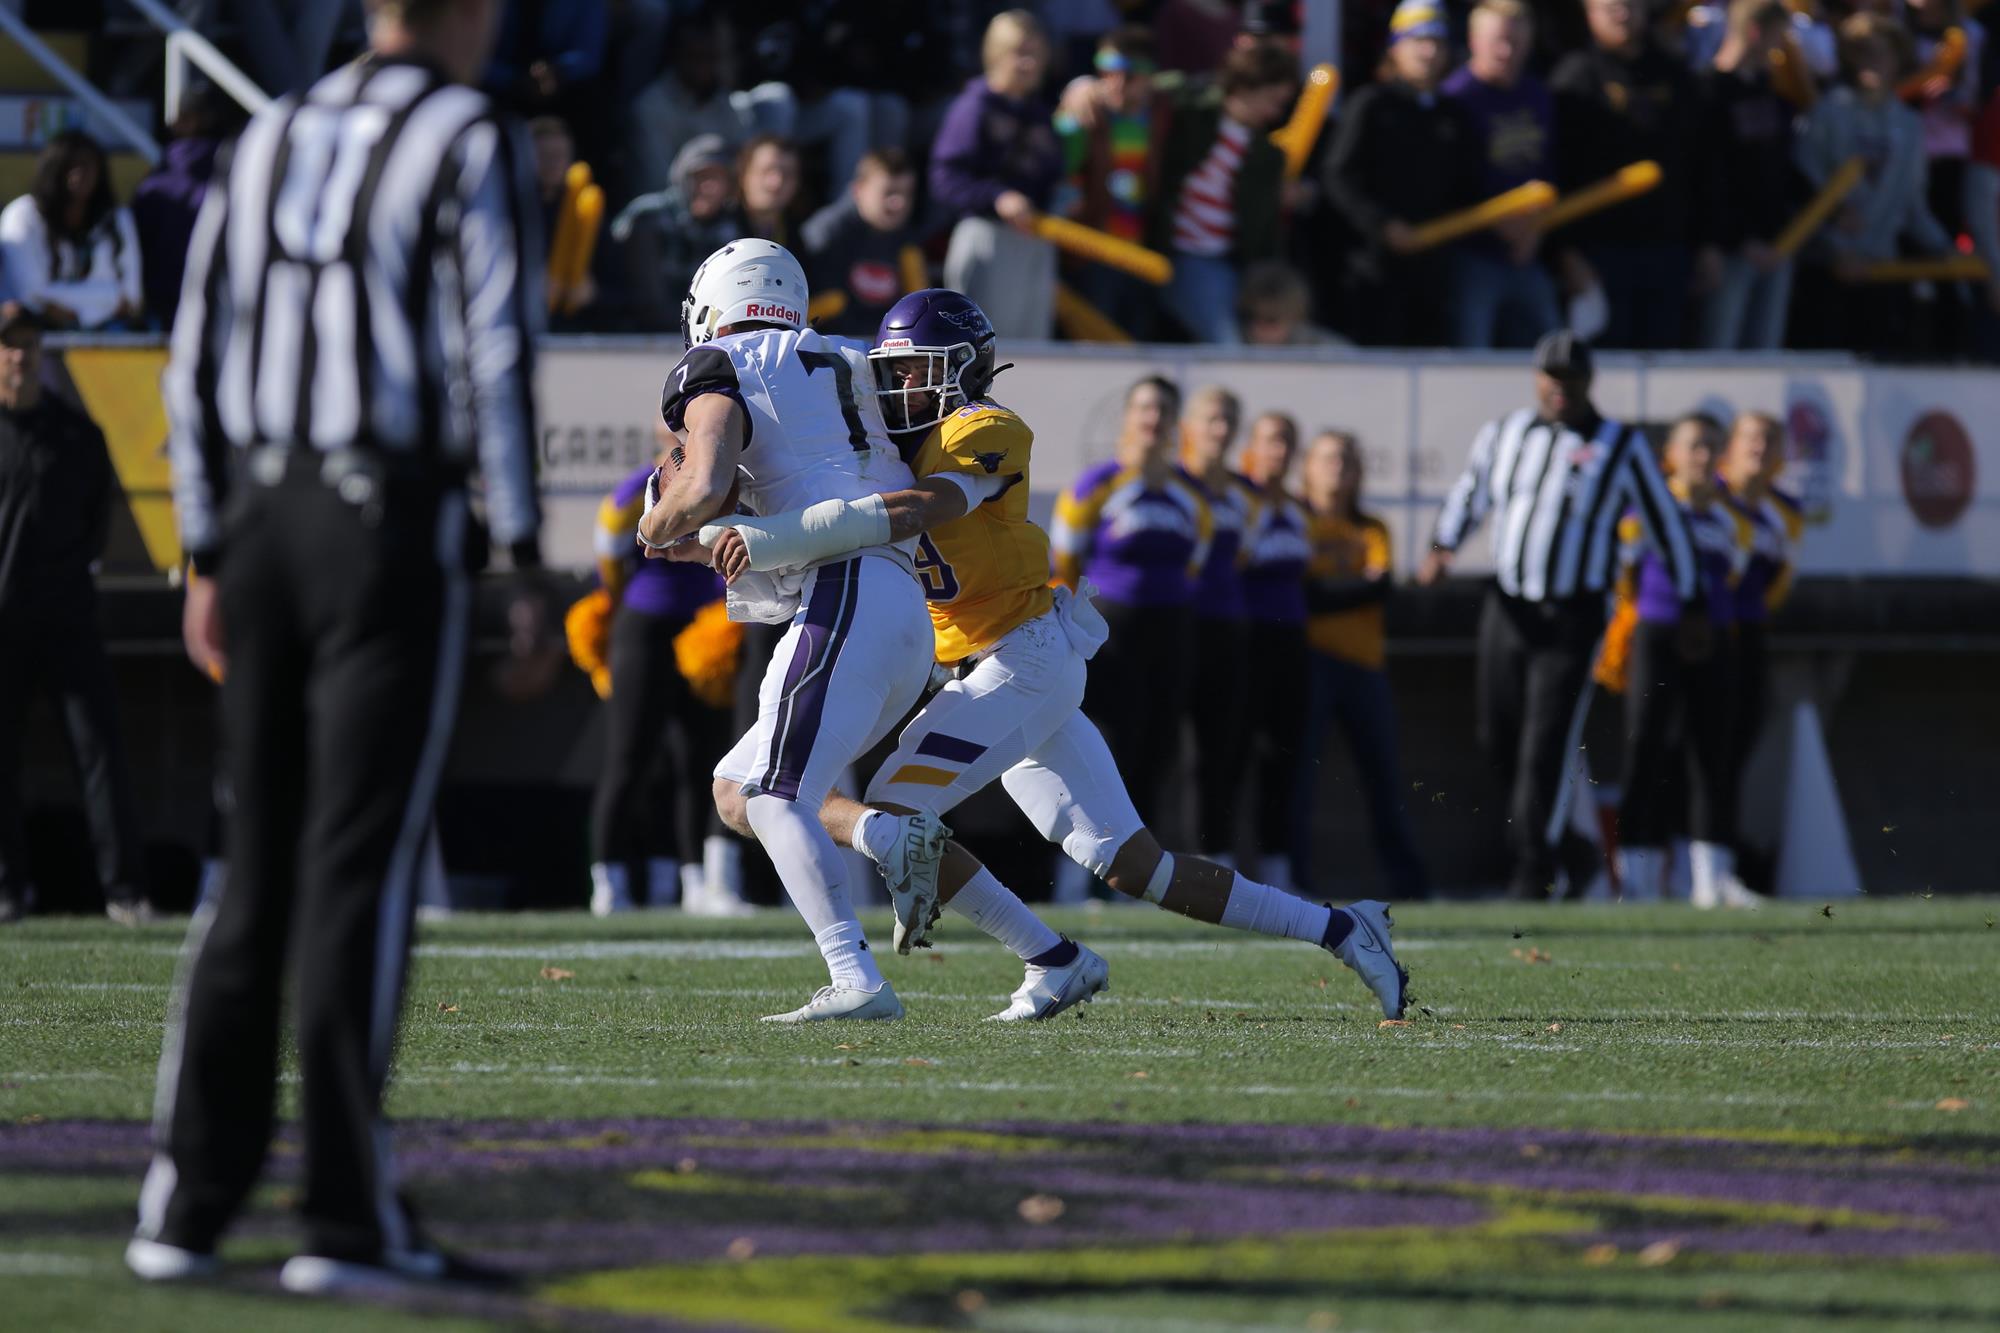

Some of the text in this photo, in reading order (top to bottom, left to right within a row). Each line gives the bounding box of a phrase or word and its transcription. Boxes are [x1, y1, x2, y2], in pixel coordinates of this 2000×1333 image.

[746, 303, 801, 326] Riddell
[883, 340, 909, 348] Riddell
[675, 363, 689, 394] 7
[795, 348, 871, 452] 7
[907, 815, 931, 898] VAPOR
